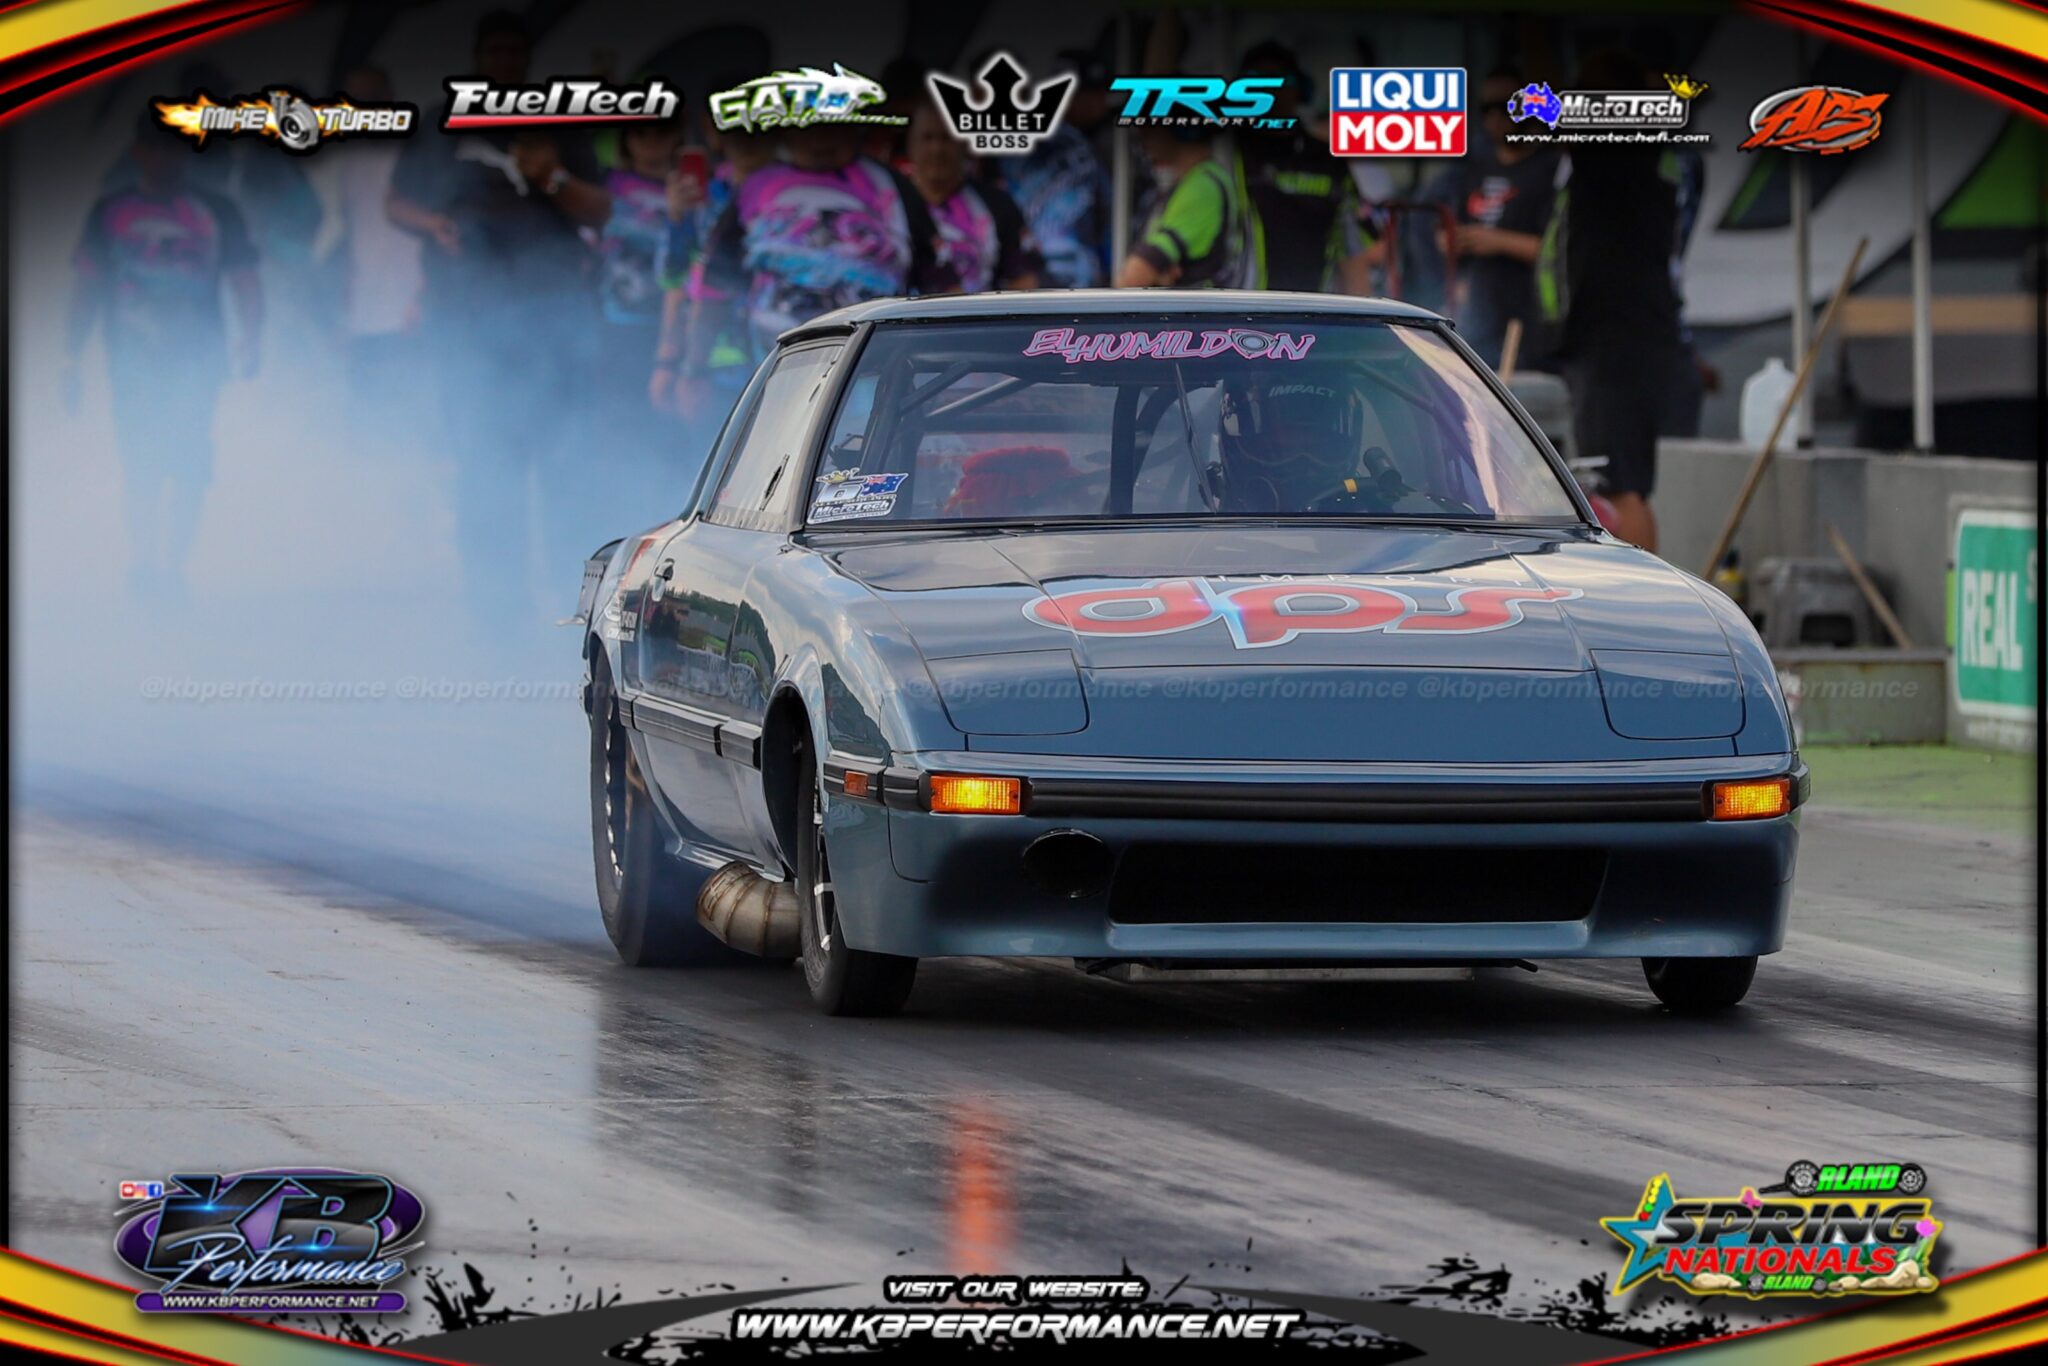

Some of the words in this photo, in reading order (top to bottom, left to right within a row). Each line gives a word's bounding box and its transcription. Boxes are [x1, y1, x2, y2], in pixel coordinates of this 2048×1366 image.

[1268, 384, 1337, 398] IMPACT
[1022, 576, 1584, 650] dps
[1960, 566, 2024, 672] REAL
